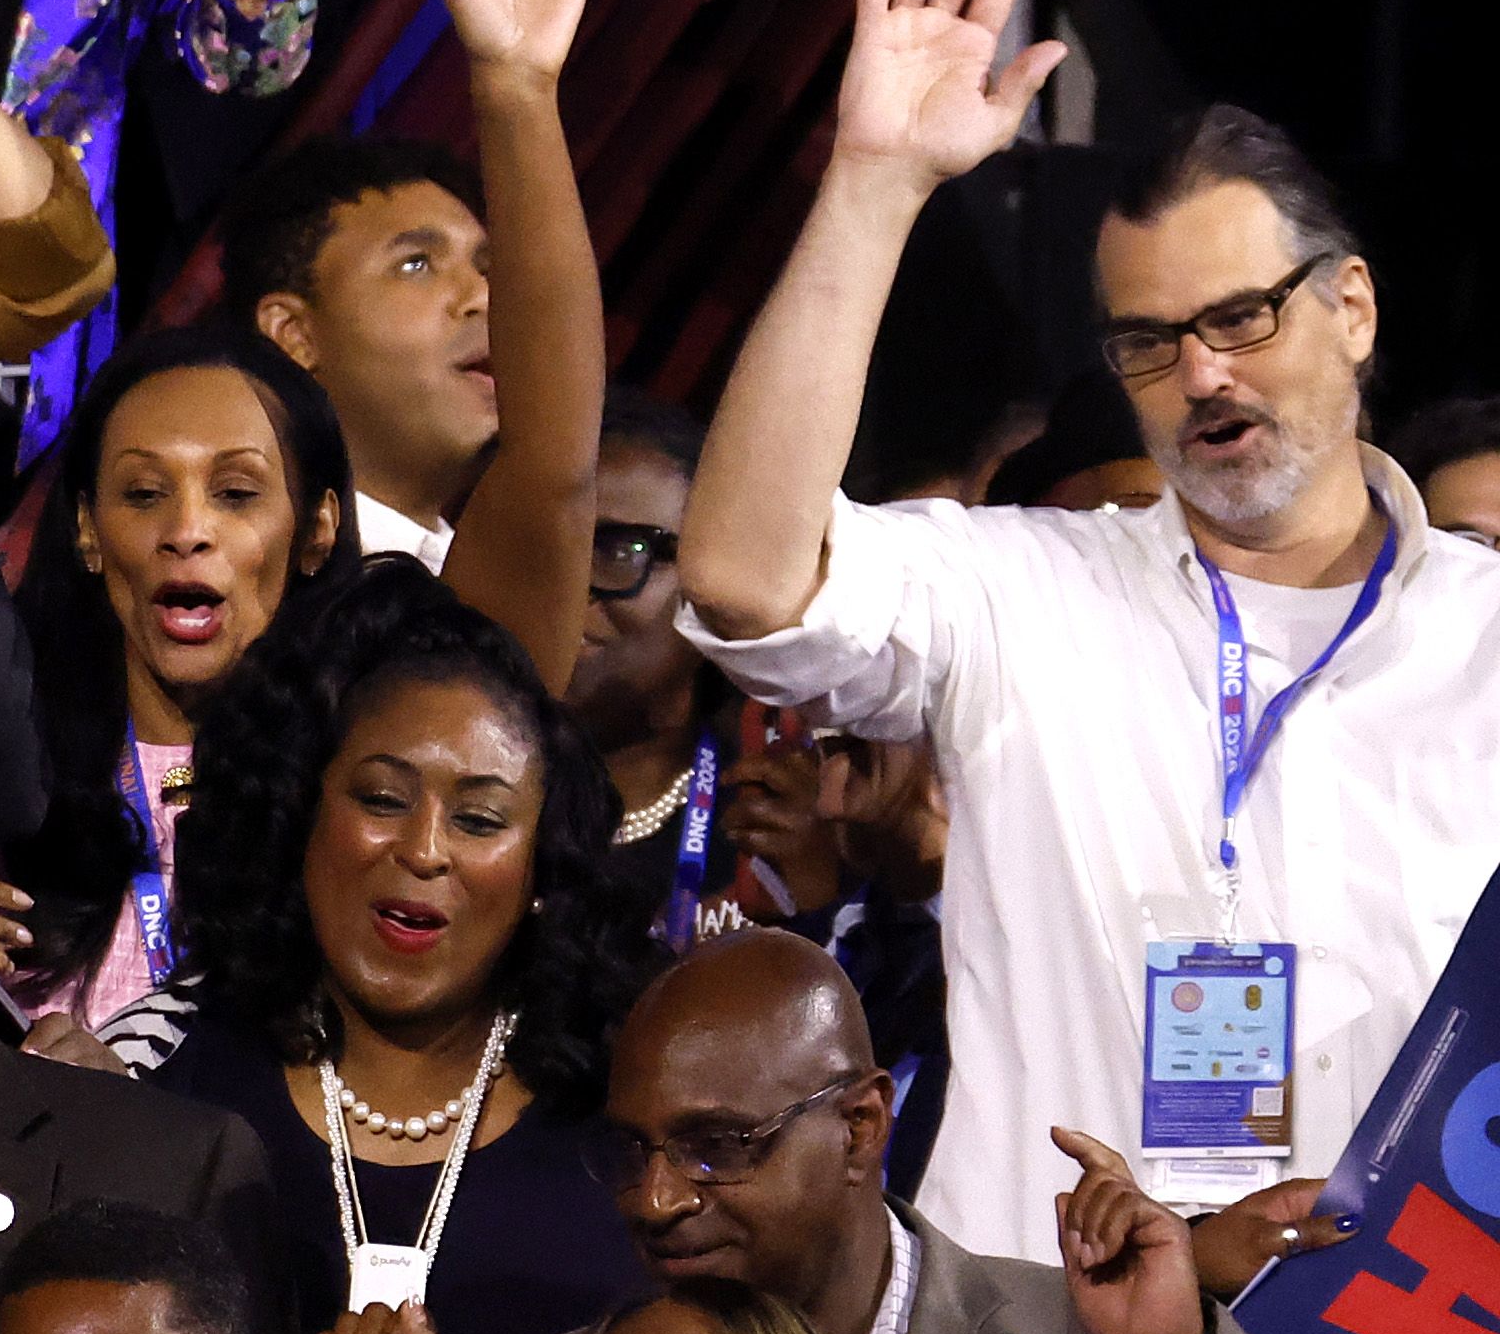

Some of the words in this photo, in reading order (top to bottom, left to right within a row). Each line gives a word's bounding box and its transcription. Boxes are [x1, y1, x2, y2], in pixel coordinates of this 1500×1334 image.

[1222, 642, 1243, 695] DNC
[686, 808, 709, 852] DNC
[140, 894, 167, 949] DNC
